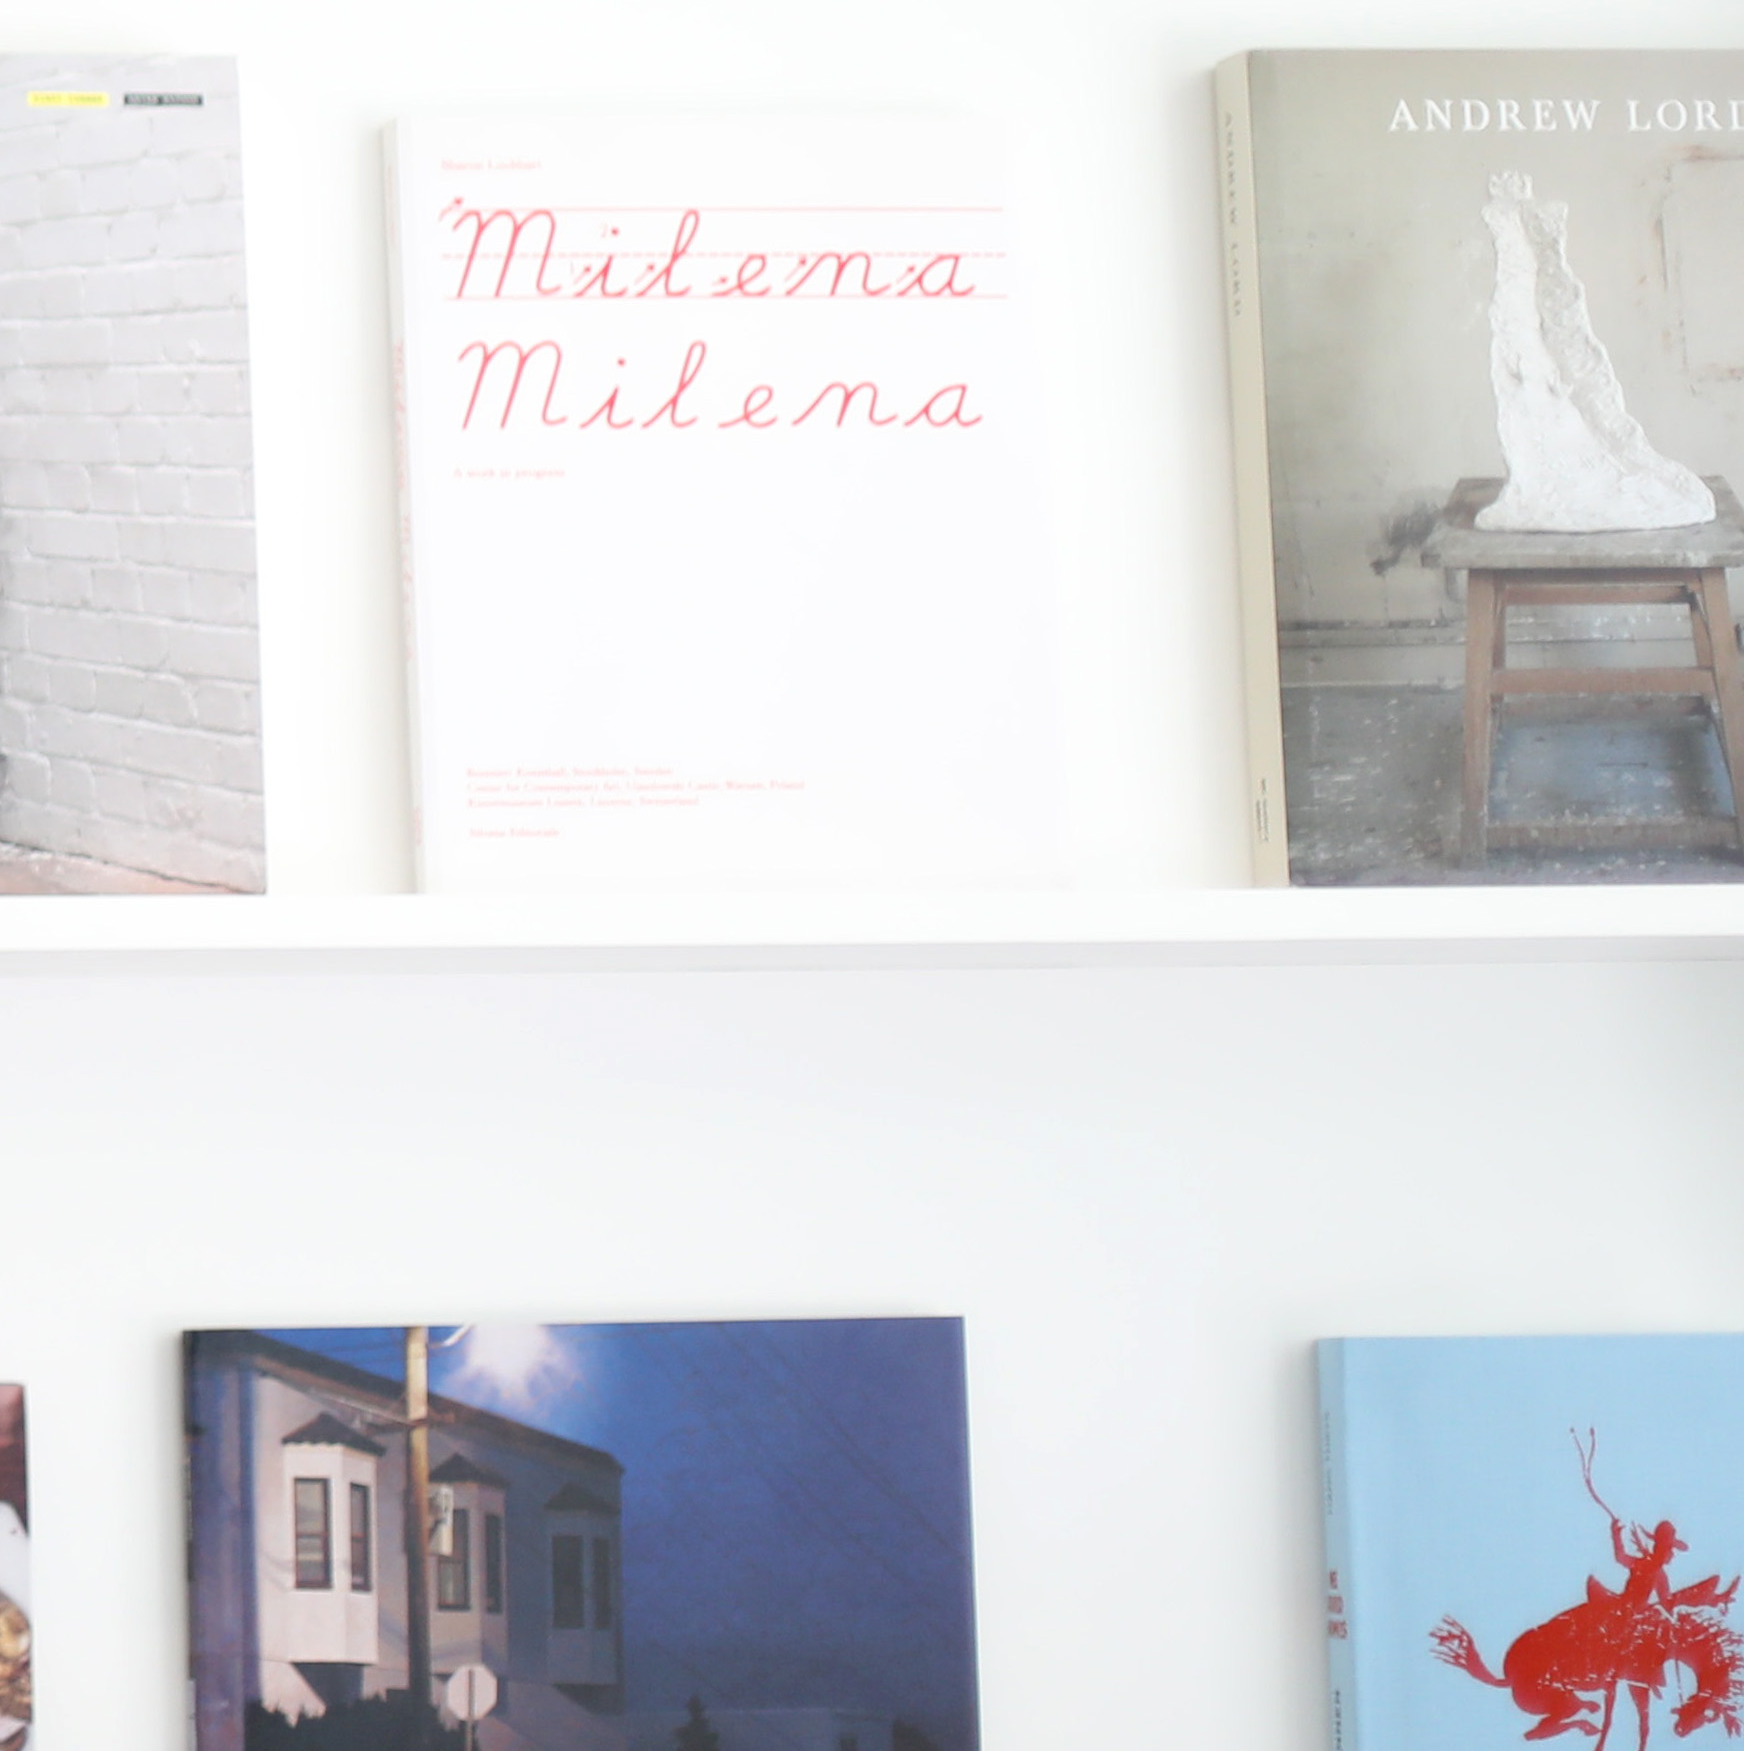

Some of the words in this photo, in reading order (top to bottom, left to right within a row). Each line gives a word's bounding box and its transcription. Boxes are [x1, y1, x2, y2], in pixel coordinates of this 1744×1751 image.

[1389, 99, 1601, 133] ANDREW
[452, 208, 977, 300] Milena
[458, 340, 984, 430] Milena
